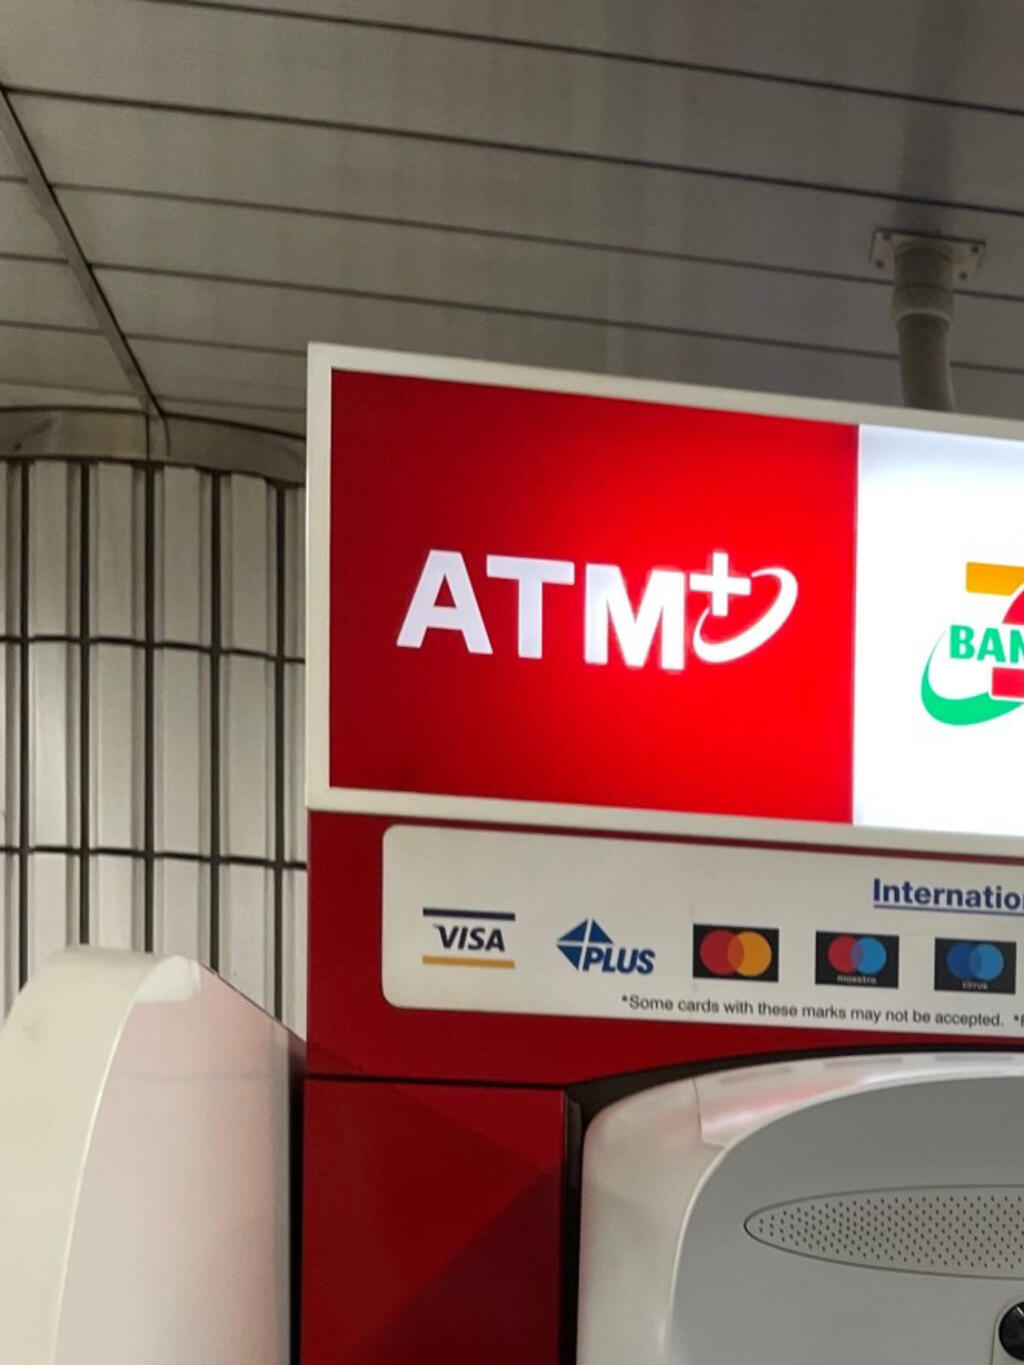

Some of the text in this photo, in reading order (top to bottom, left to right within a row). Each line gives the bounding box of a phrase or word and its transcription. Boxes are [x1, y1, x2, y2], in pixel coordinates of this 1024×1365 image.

[434, 924, 505, 951] VISA
[581, 947, 655, 975] PLUS
[678, 999, 719, 1013] cards
[724, 1000, 753, 1014] with
[758, 1001, 798, 1016] these
[801, 1005, 846, 1019] marks
[851, 1009, 881, 1024] may
[886, 1010, 908, 1022] not
[913, 1010, 931, 1024] be
[935, 1013, 1004, 1028] accepted.
